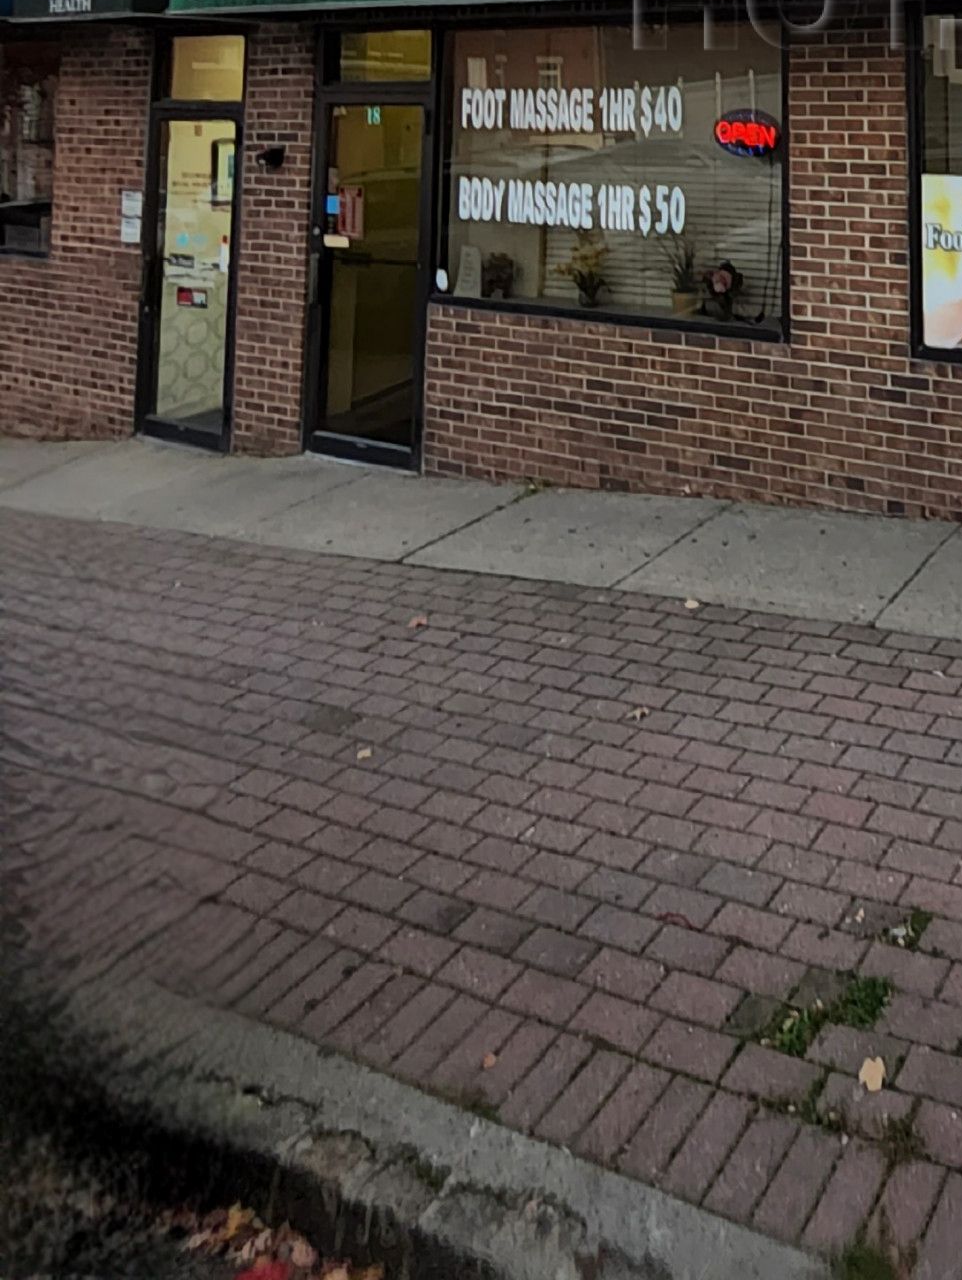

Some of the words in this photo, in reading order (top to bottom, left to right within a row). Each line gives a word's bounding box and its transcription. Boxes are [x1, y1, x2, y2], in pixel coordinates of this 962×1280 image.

[366, 106, 381, 125] 18
[462, 88, 505, 129] FOOT
[510, 88, 593, 132] MASSAGE
[715, 121, 776, 149] OPEN
[459, 176, 505, 221] BODY
[508, 179, 593, 229] MASSAGE
